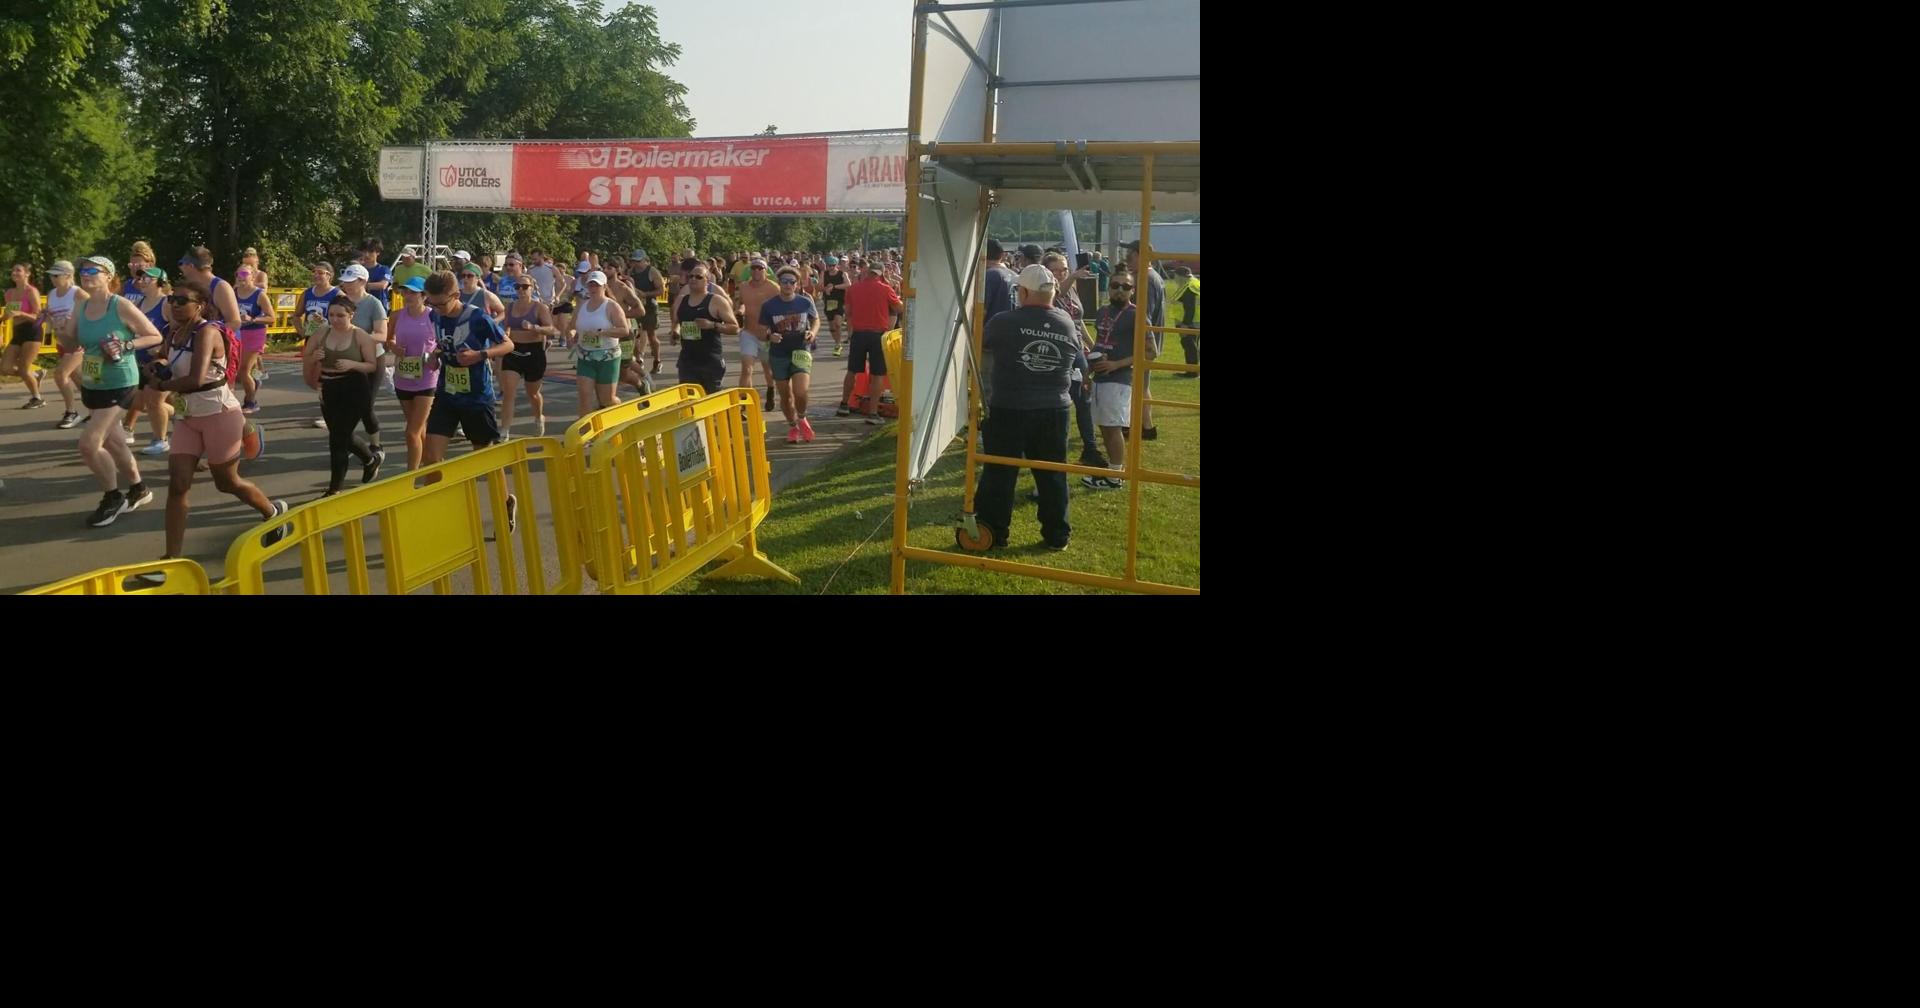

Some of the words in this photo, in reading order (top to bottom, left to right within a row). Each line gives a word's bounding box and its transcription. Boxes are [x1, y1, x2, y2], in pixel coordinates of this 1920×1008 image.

[613, 144, 770, 169] Boilermaker
[458, 178, 501, 188] BOILERS
[587, 175, 732, 206] START
[752, 196, 798, 207] UTICA,
[802, 195, 821, 205] NY
[1020, 327, 1073, 342] VOLUNTEER
[398, 360, 420, 373] 6354
